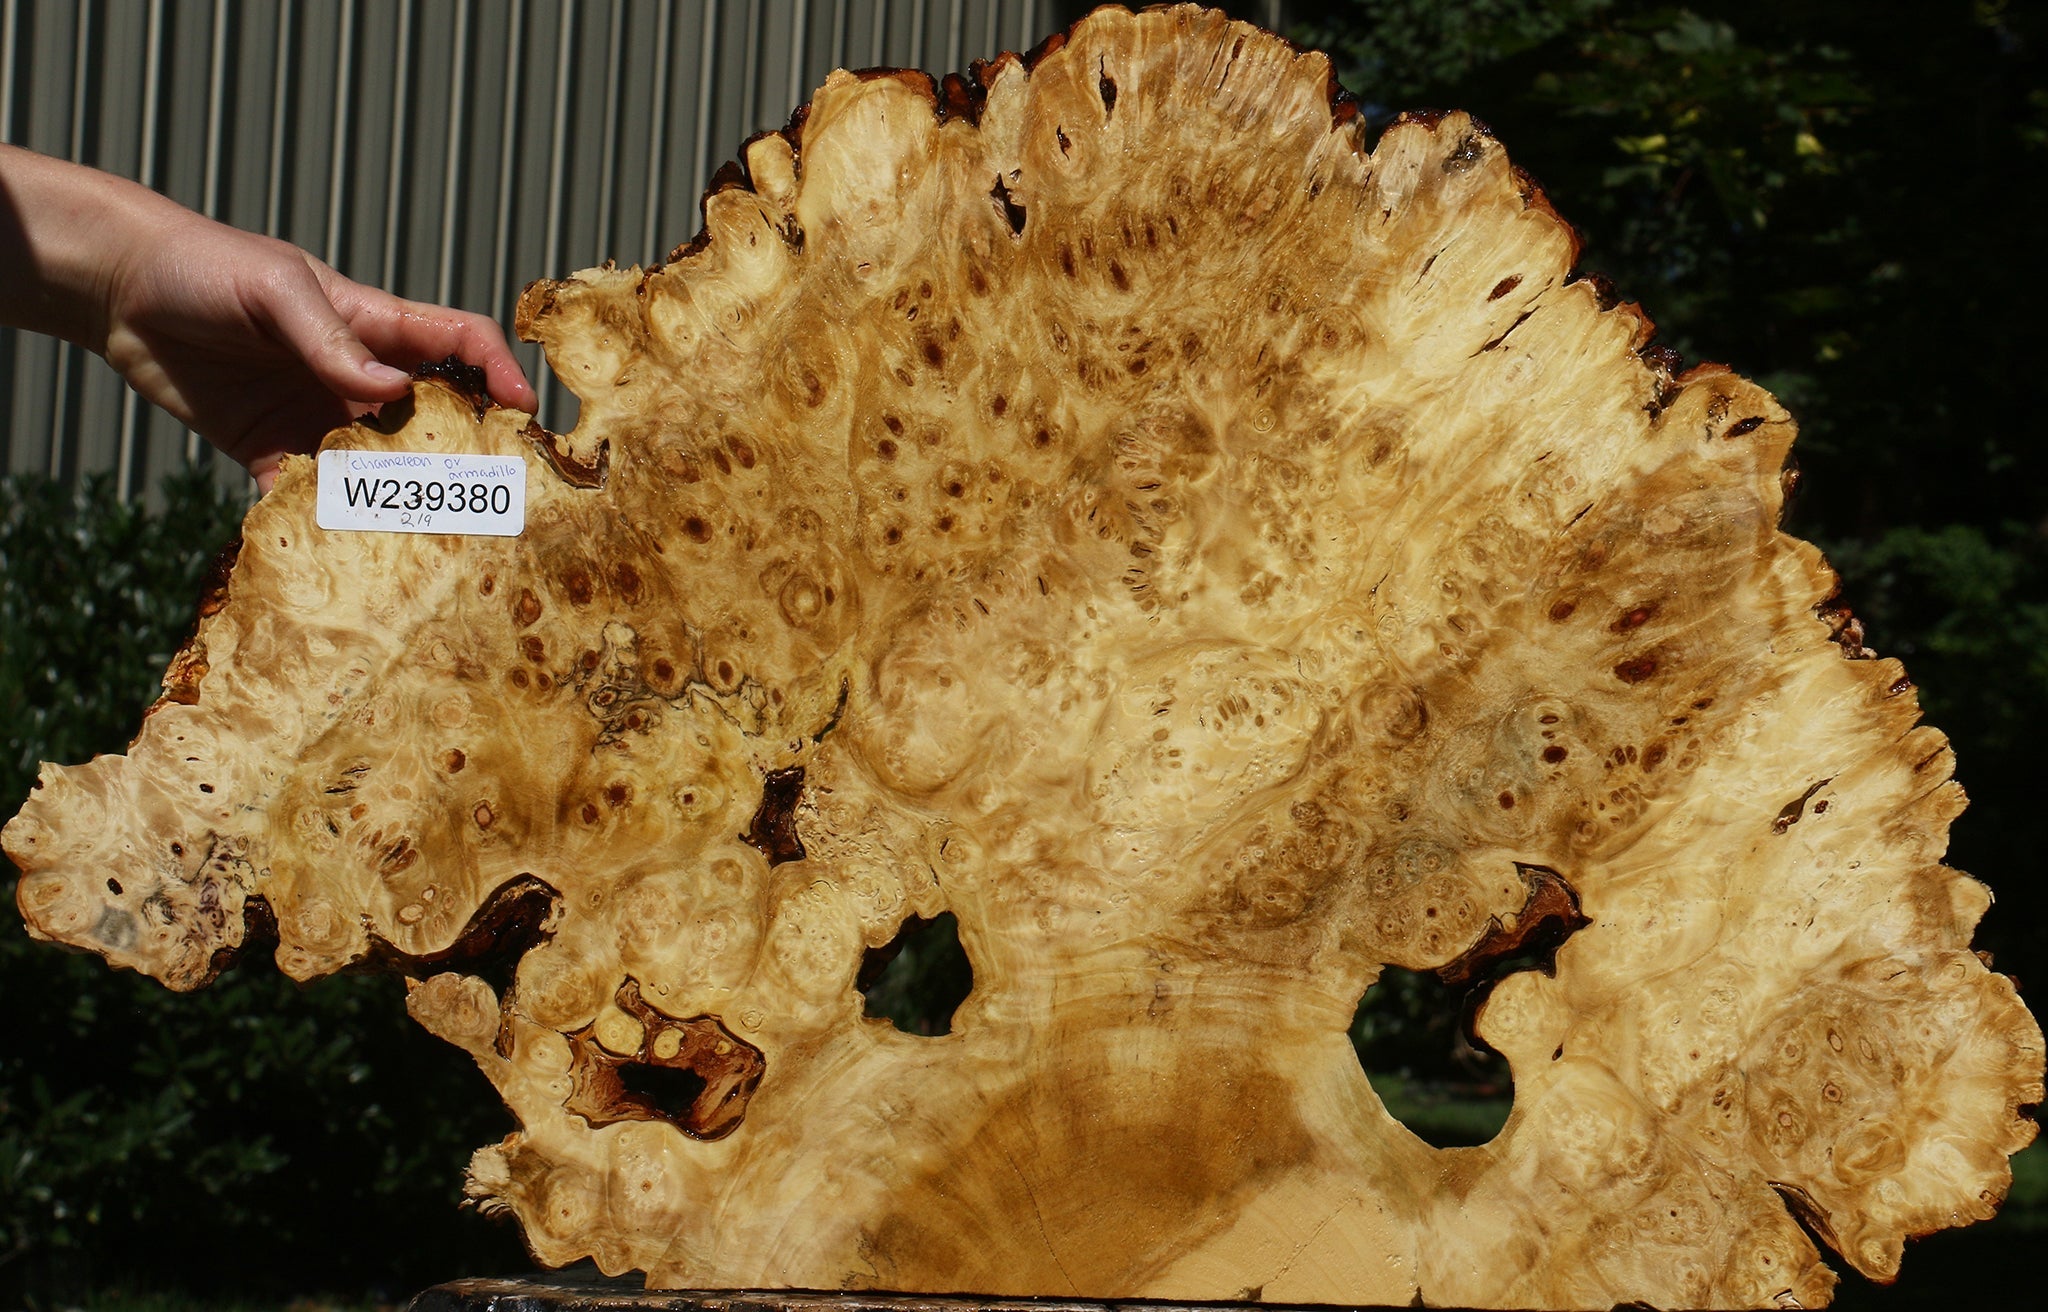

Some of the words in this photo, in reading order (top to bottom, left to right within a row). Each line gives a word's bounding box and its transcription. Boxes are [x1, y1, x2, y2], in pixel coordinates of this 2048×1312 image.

[351, 455, 432, 471] chameleon
[444, 457, 461, 470] or
[449, 465, 517, 481] armadillo
[344, 477, 511, 515] W239380
